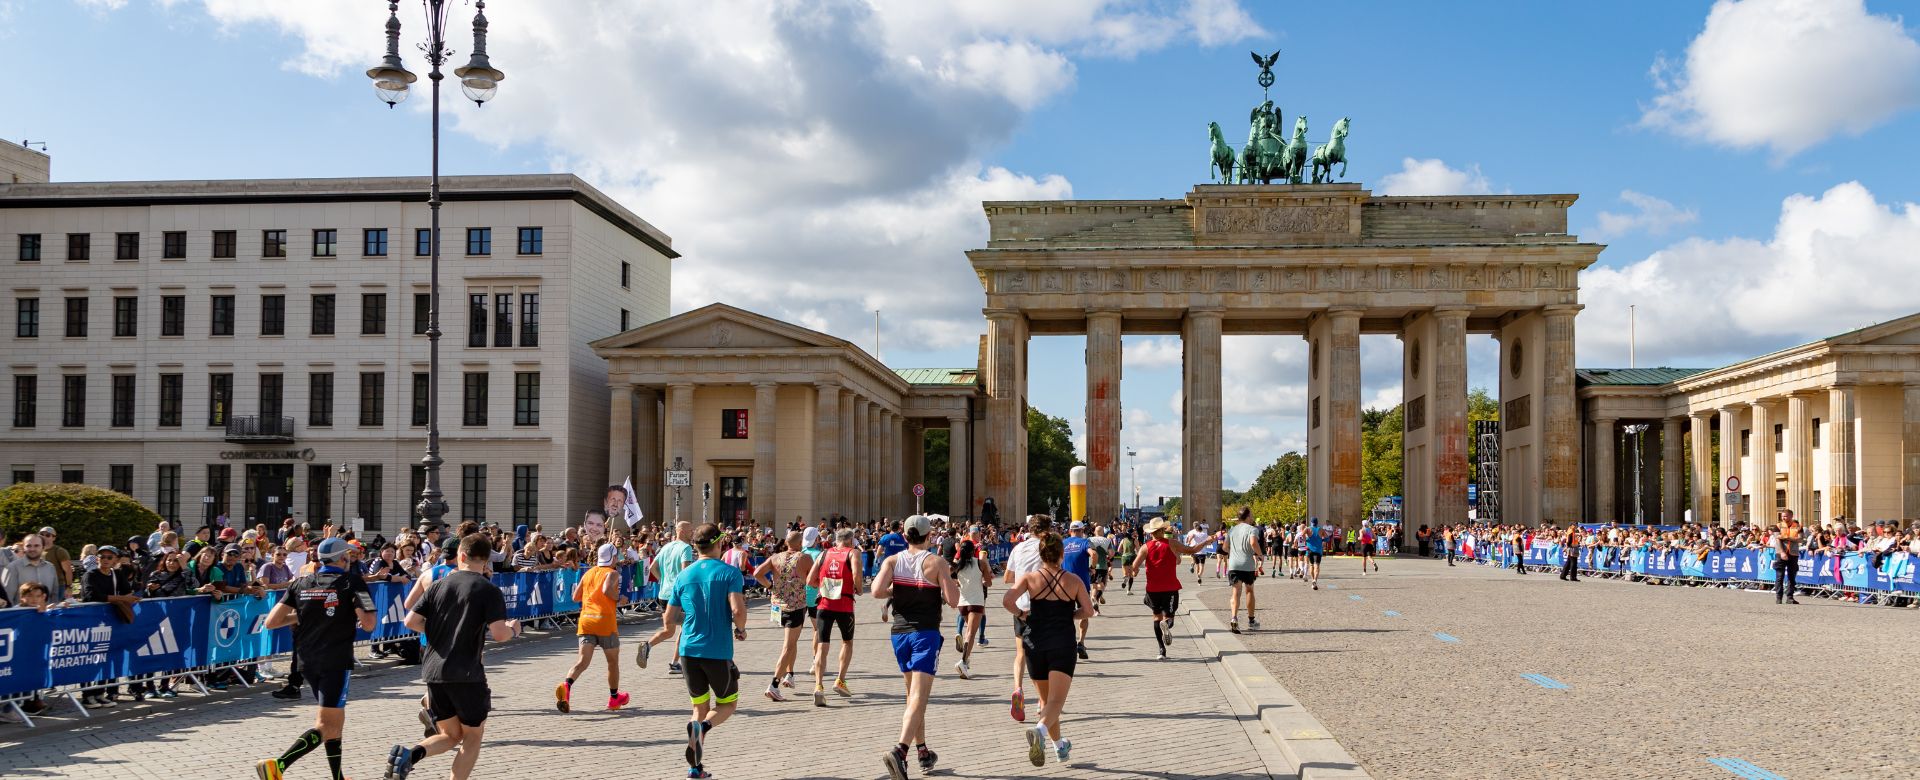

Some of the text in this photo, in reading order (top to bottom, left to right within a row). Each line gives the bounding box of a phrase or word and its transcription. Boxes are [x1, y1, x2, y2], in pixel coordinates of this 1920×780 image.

[51, 627, 90, 646] BMW
[50, 643, 89, 657] BERLIN
[49, 653, 107, 670] MARATHON
